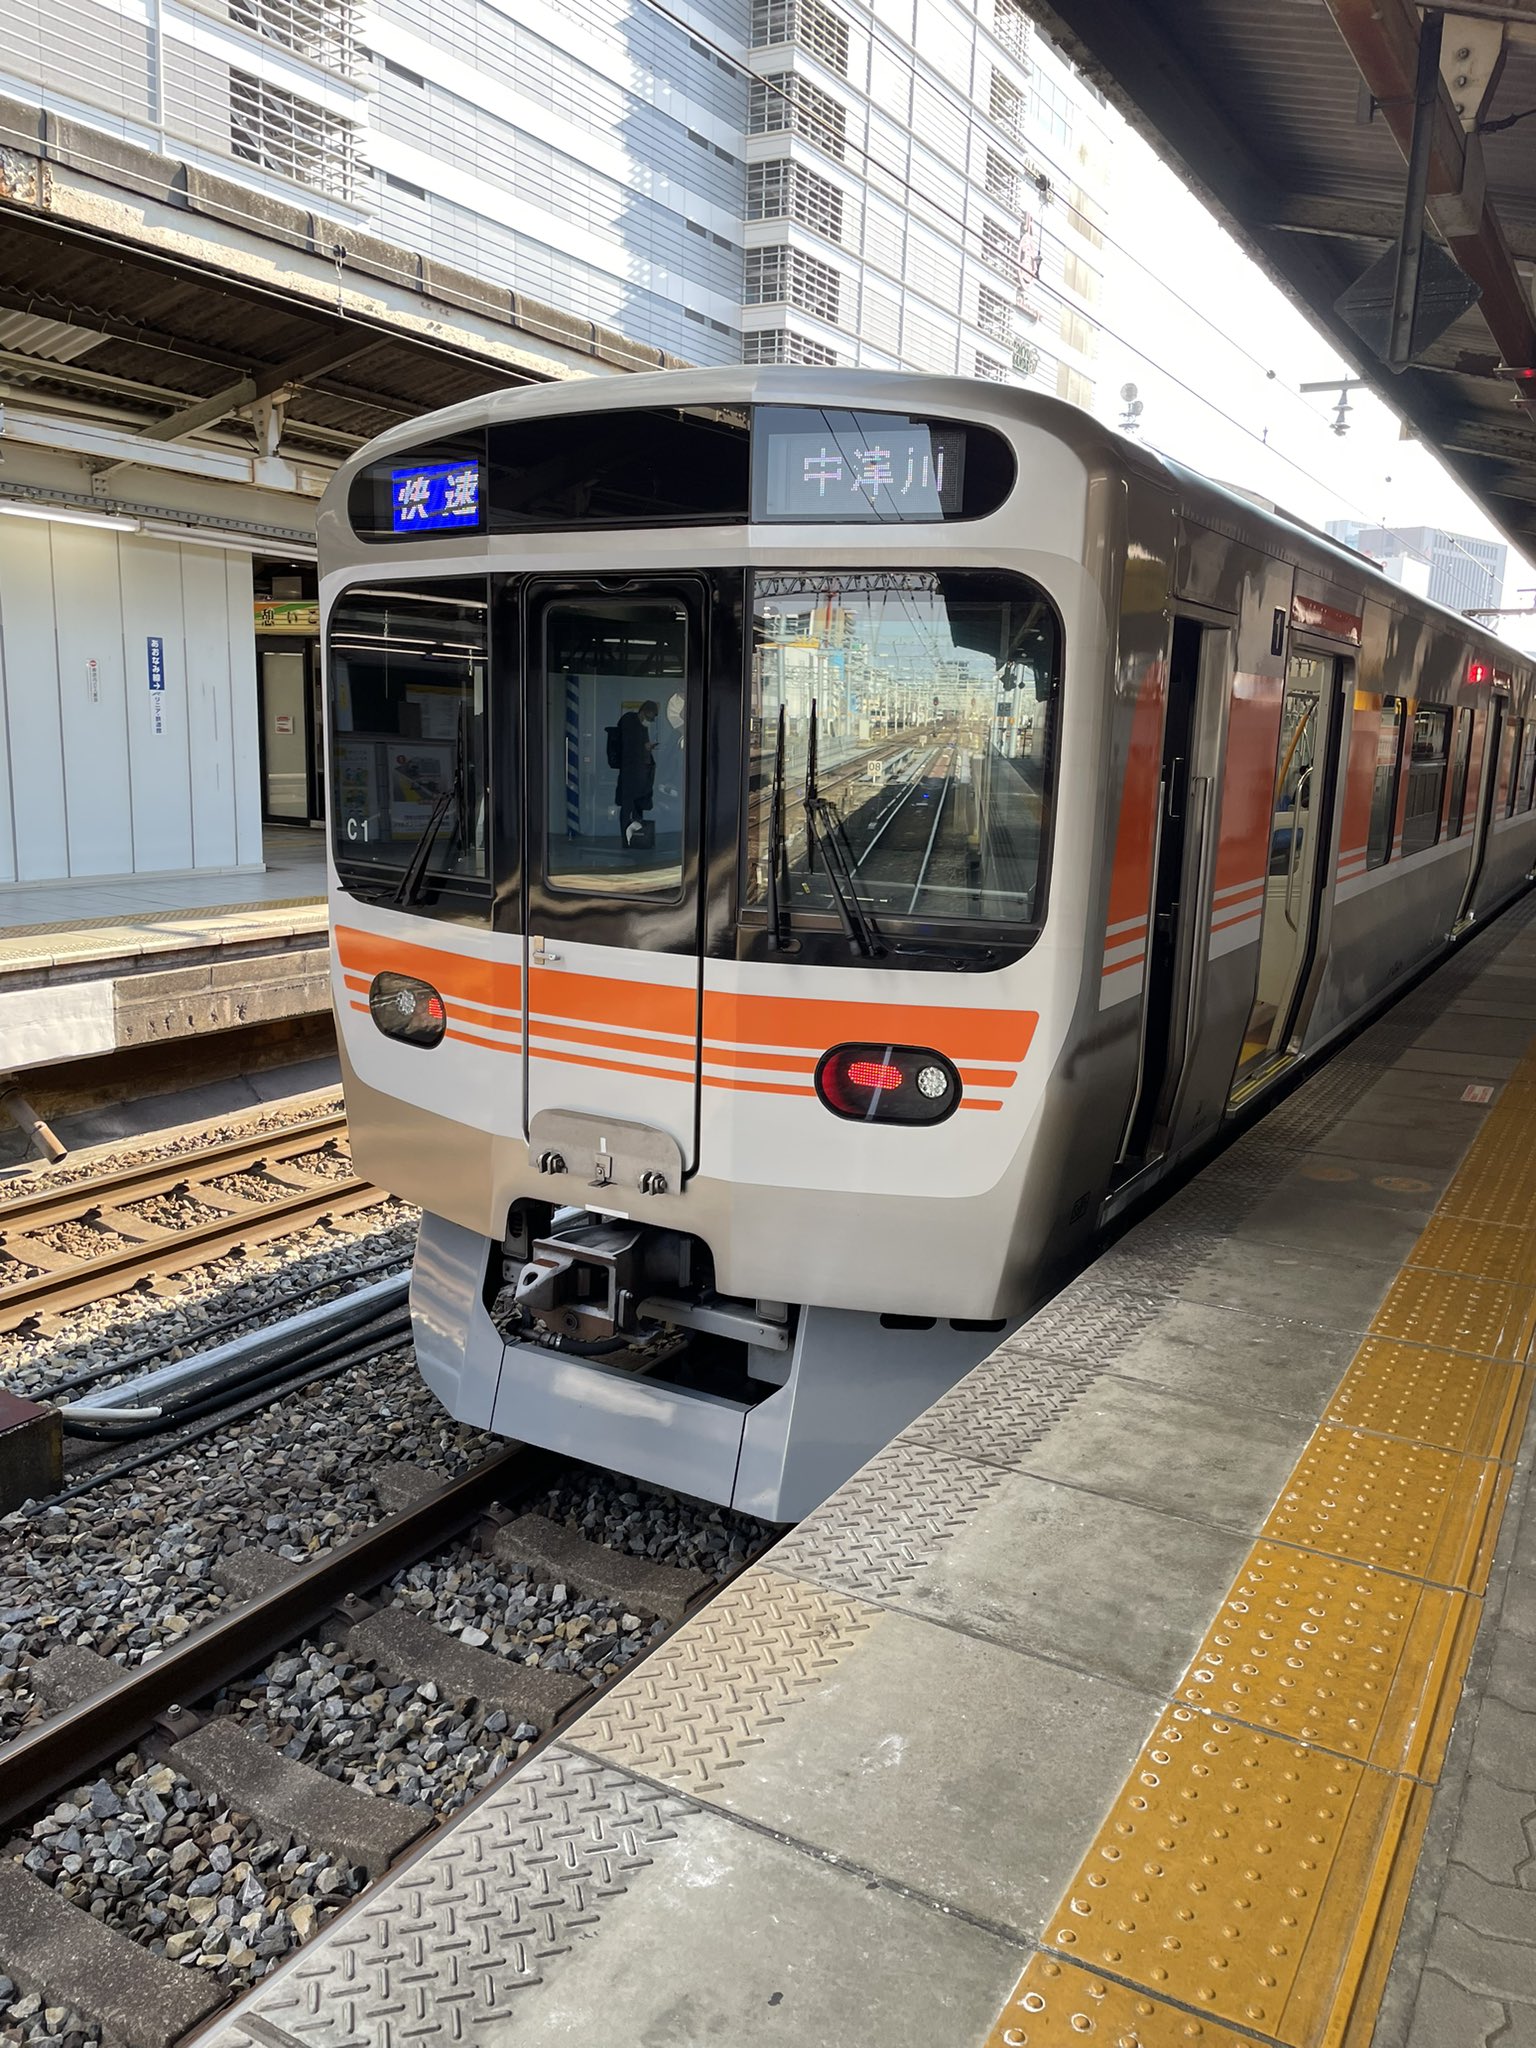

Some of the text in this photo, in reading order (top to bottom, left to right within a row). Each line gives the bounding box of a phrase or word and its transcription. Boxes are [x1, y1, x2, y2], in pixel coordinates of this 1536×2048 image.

[398, 470, 478, 520] 快速
[804, 445, 944, 496] 中津川
[347, 817, 369, 842] C1
